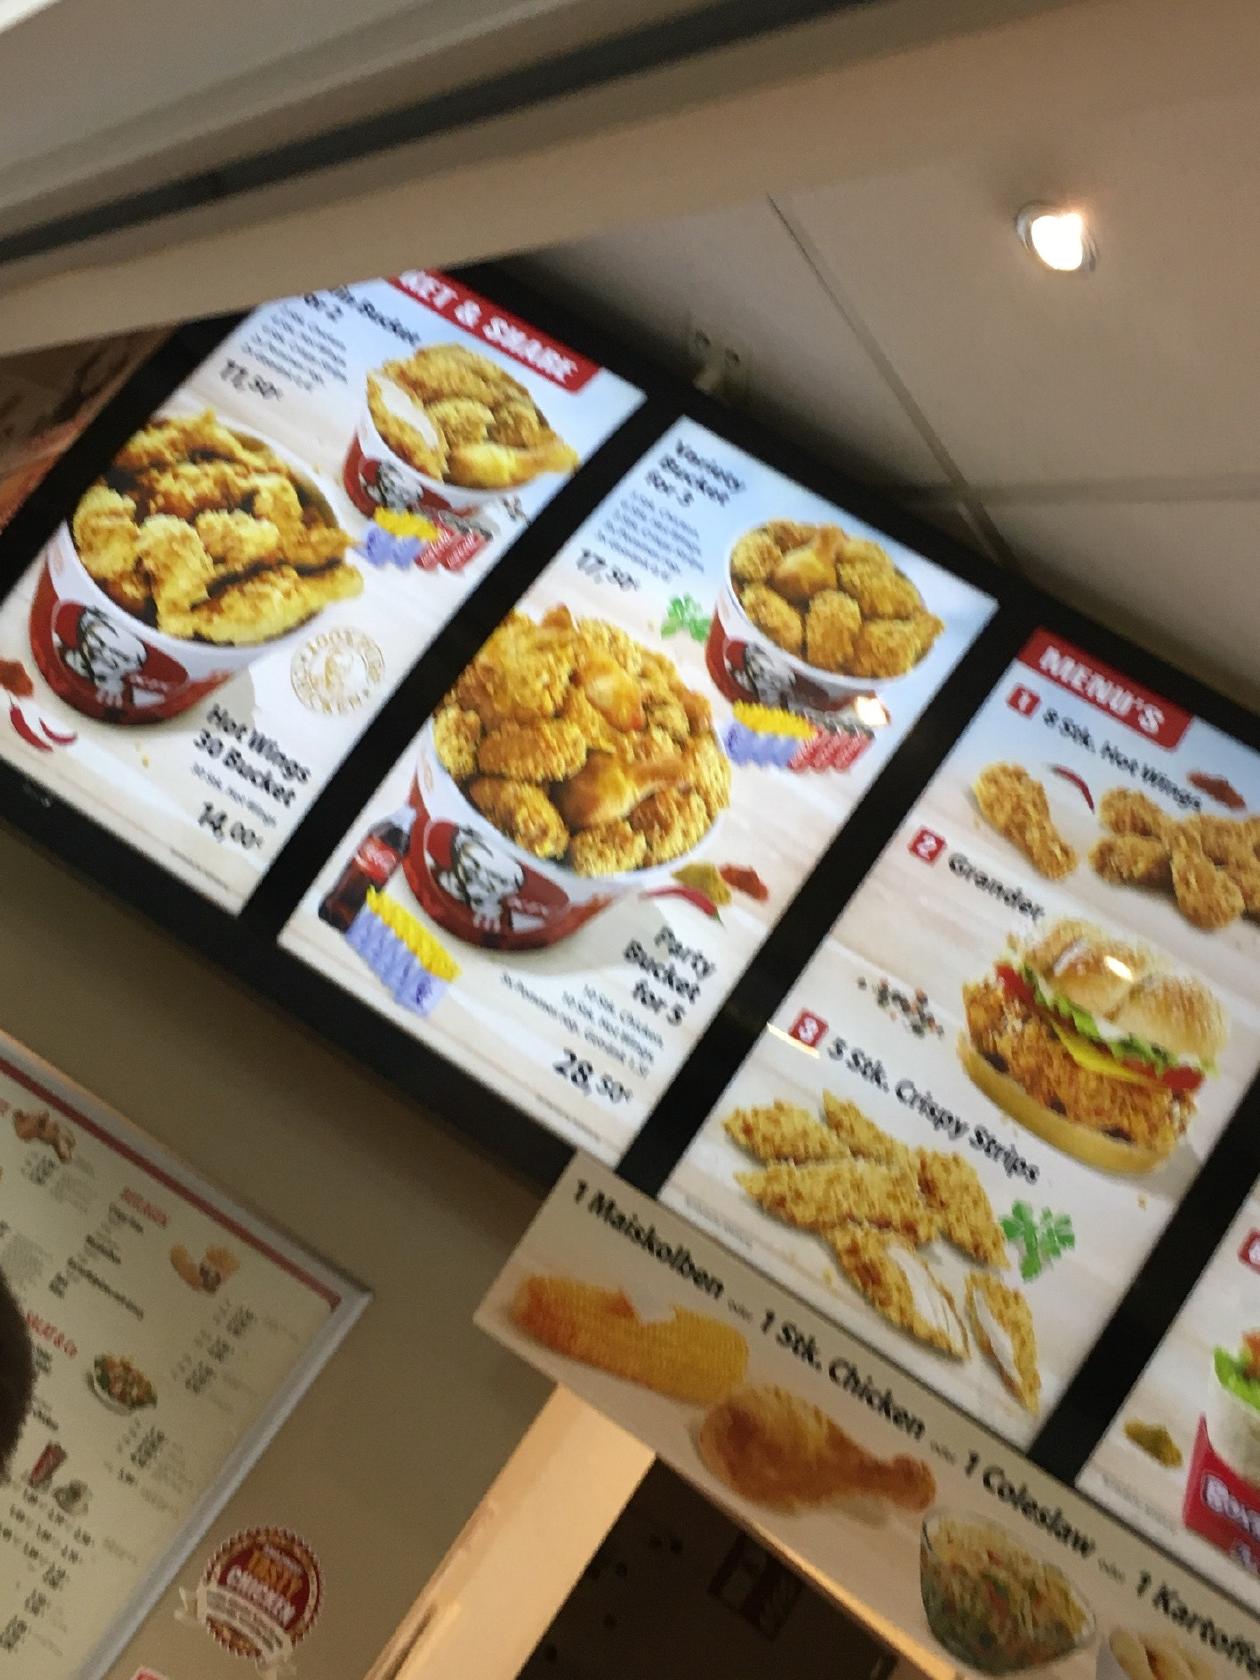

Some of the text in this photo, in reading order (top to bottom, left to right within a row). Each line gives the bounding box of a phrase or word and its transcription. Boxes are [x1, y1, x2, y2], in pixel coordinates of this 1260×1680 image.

[455, 300, 481, 328] &
[482, 316, 578, 383] SHARE
[659, 453, 730, 507] Bucket
[1039, 645, 1165, 735] MENU'S
[193, 728, 223, 759] 30
[222, 747, 296, 808] Bucket
[206, 702, 247, 743] Hot
[248, 727, 312, 784] Wings
[1100, 739, 1138, 777] Hot
[1141, 757, 1202, 812] Wings
[917, 834, 1045, 925] 2 Grander
[623, 937, 700, 1004] Bucket
[654, 925, 716, 980] Party
[632, 978, 686, 1026] for 5
[827, 1037, 848, 1061] 5
[847, 1047, 889, 1094] Stk.
[895, 1078, 969, 1141] Crispy
[969, 1124, 1040, 1186] Strips
[574, 1178, 588, 1205] 1
[588, 1189, 724, 1300] Maiskolben
[761, 1309, 776, 1335] 1
[776, 1320, 822, 1373] Stk.
[828, 1356, 926, 1443] Chicken
[964, 1451, 980, 1479] 1
[982, 1465, 1097, 1559] Coleslaw
[1136, 1570, 1152, 1598] 1
